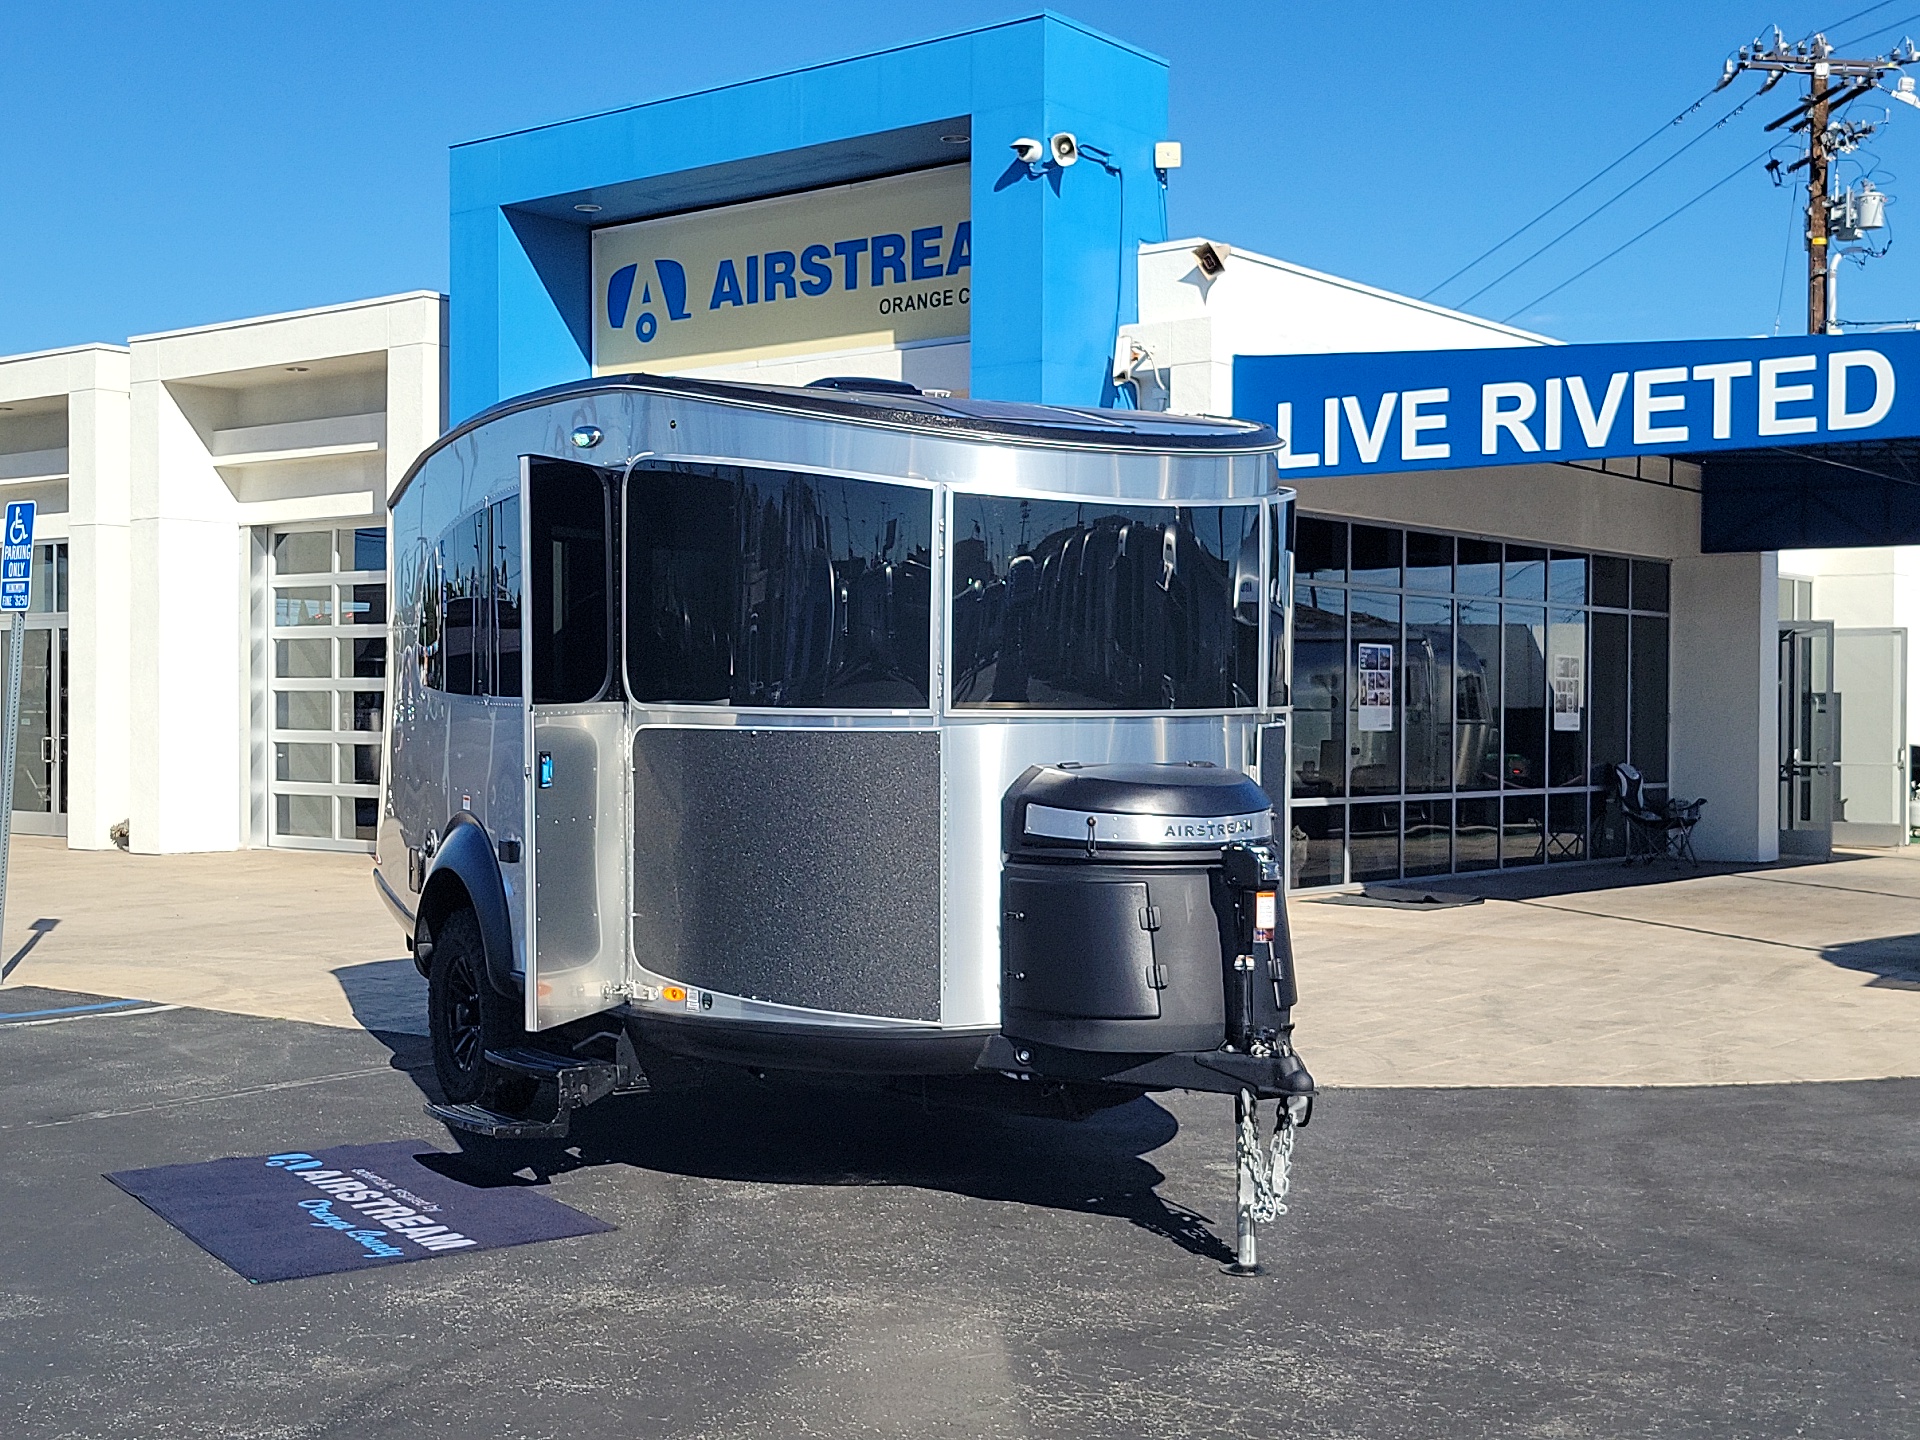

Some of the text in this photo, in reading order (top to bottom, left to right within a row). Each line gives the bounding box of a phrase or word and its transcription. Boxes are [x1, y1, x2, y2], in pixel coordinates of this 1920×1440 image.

[709, 220, 971, 310] AIRSTREA
[879, 290, 953, 315] ORANGE
[1277, 349, 1896, 469] LIVE RIVETED
[5, 544, 31, 560] PARKING
[8, 562, 25, 578] ONLY
[1164, 819, 1253, 837] AIRSTREAM
[294, 1169, 478, 1251] AIRSTREAM
[298, 1199, 404, 1258] Orange County
